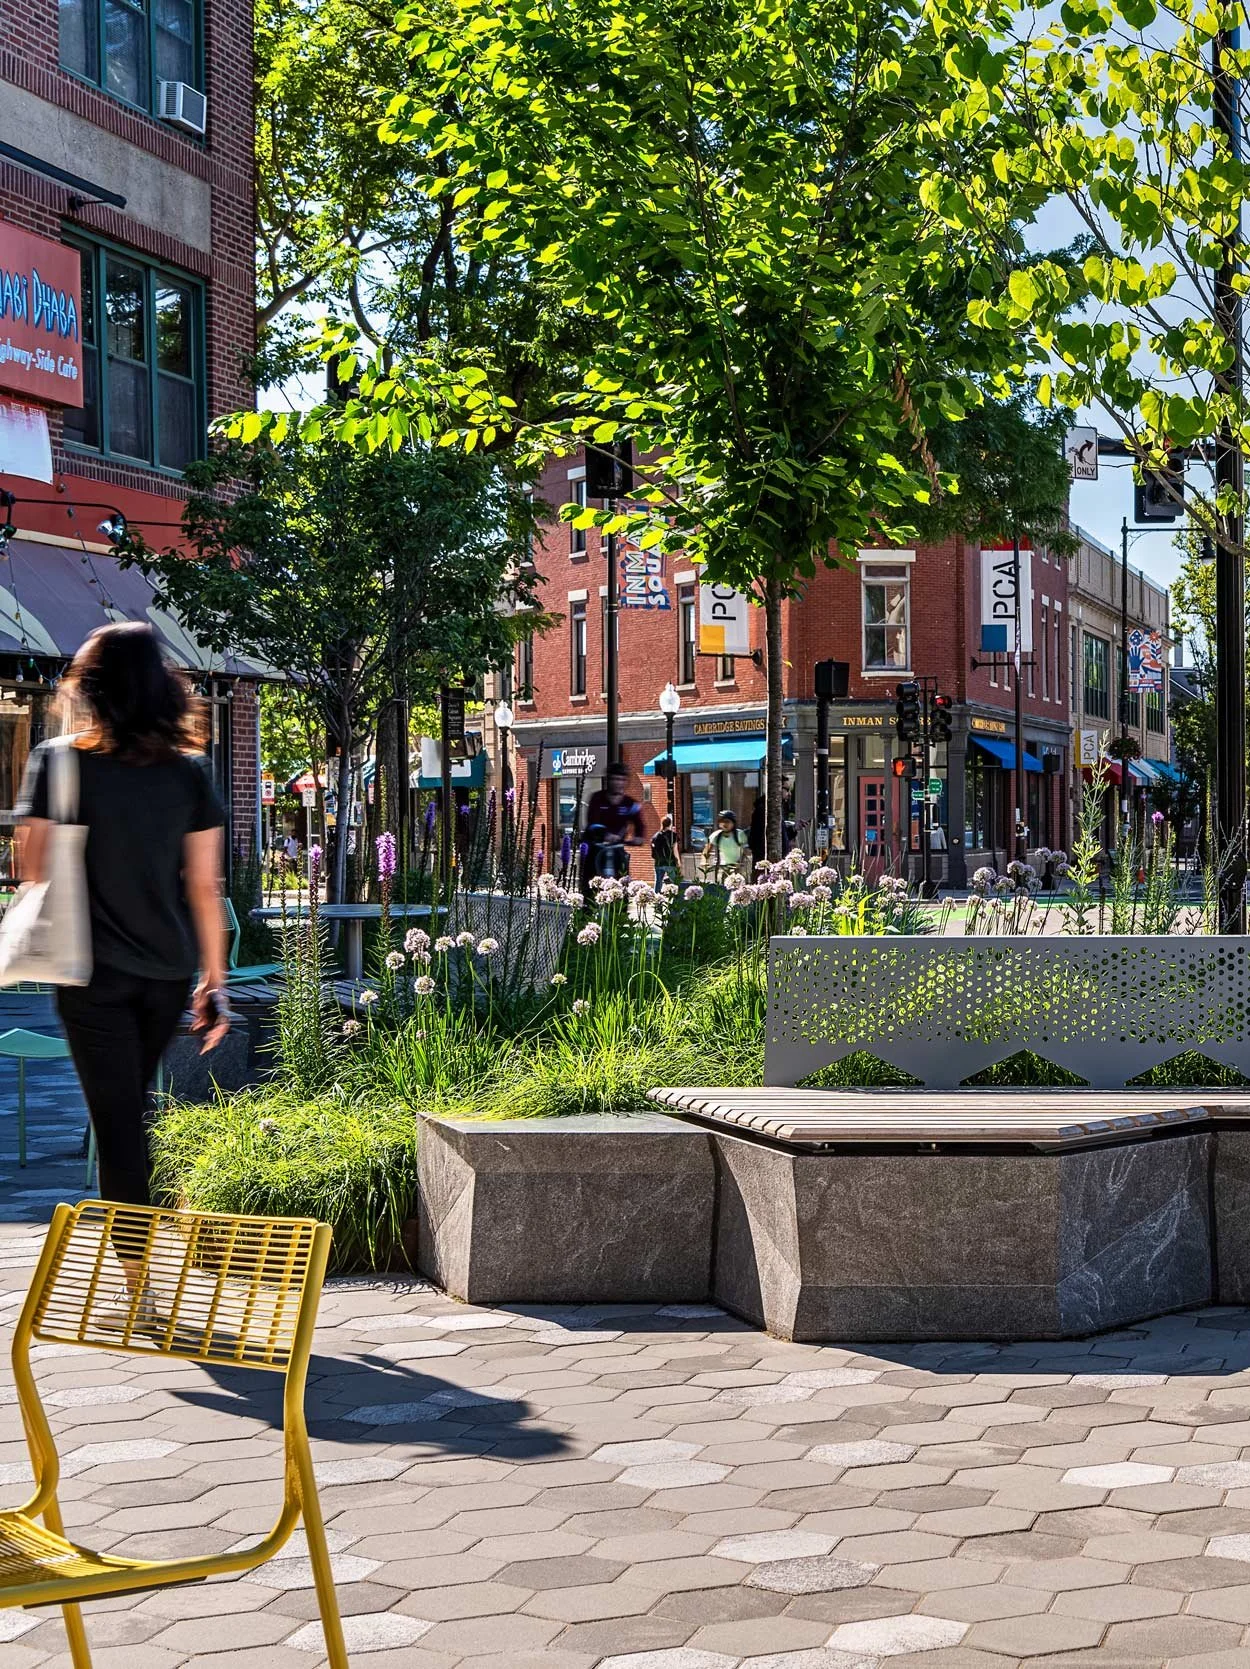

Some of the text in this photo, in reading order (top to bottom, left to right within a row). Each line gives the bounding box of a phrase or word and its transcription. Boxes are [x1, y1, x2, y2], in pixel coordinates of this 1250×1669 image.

[33, 267, 78, 343] DHABA
[0, 337, 78, 380] ghway-Side Cafe
[1076, 466, 1095, 476] ONLY
[626, 510, 647, 605] INMA
[712, 582, 736, 621] PC
[993, 560, 1016, 619] PCA
[734, 718, 765, 733] SAVINGS
[843, 716, 883, 726] INMAN
[561, 748, 596, 772] Cambridge
[1083, 734, 1095, 760] PCA
